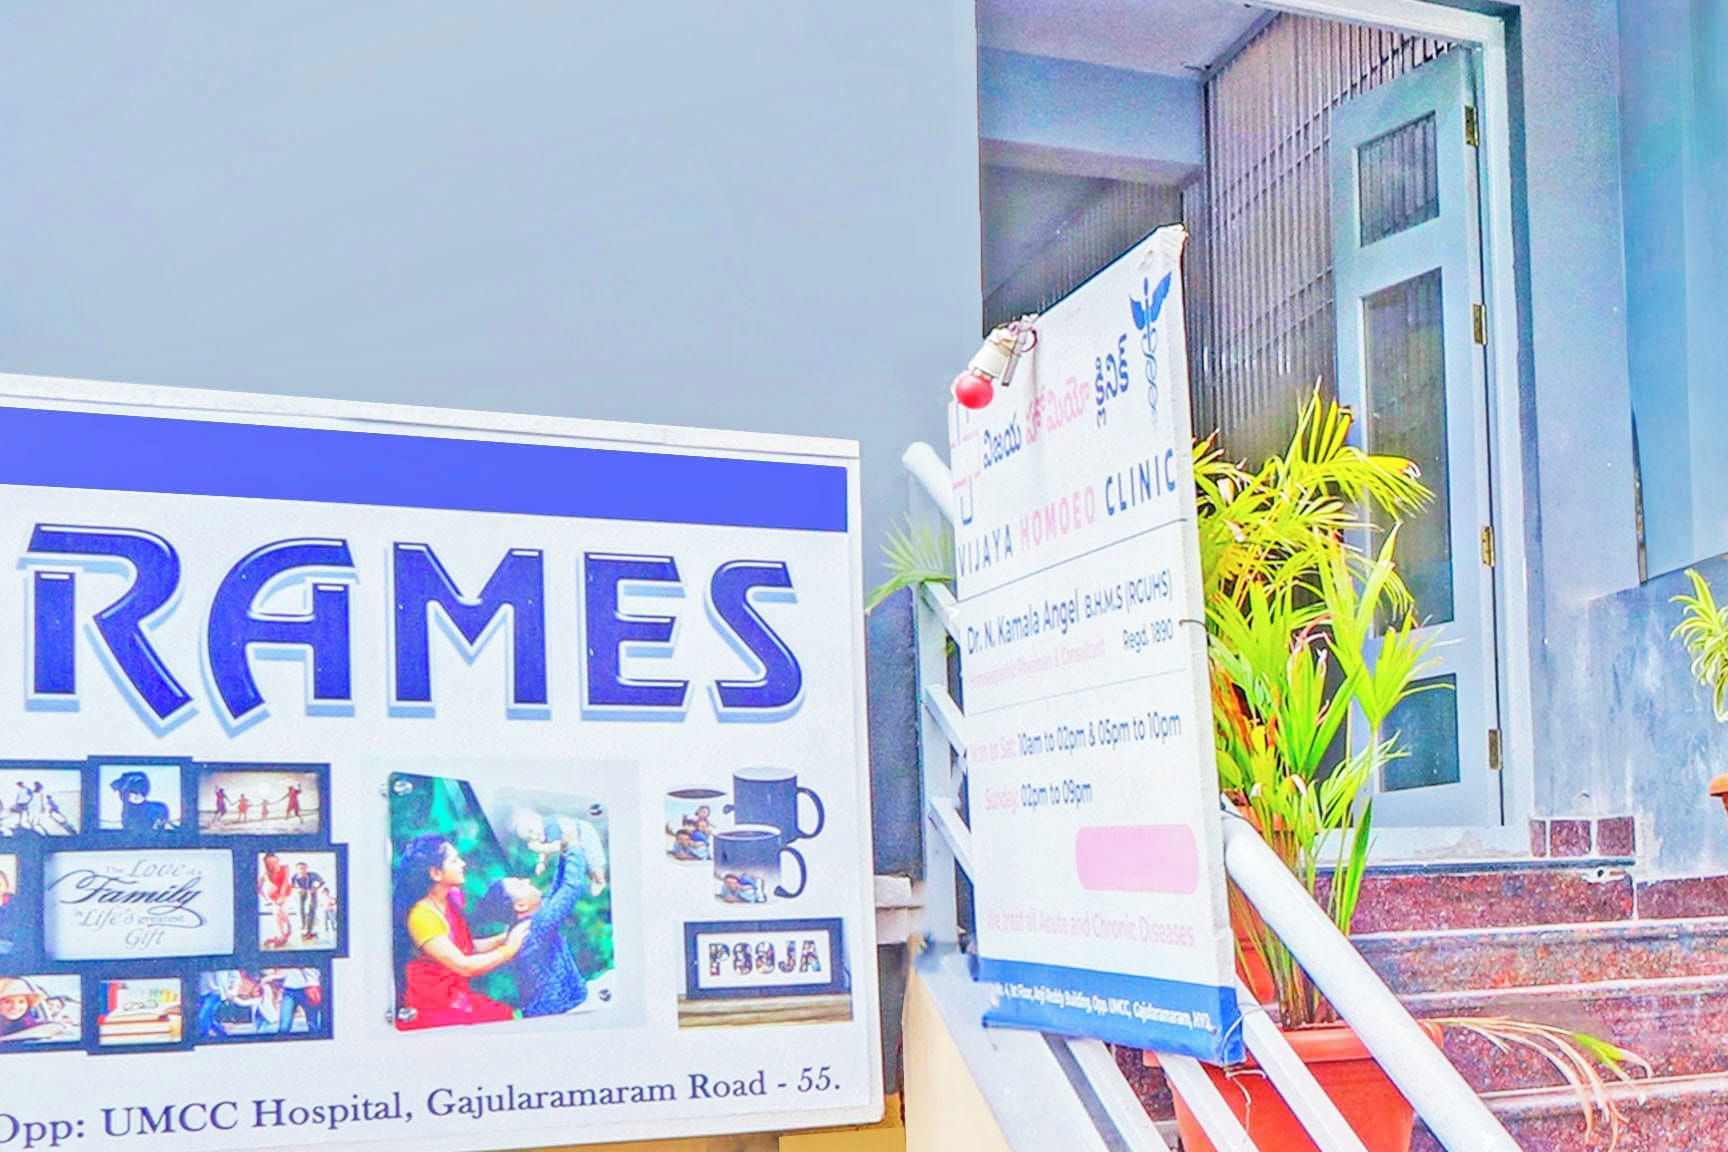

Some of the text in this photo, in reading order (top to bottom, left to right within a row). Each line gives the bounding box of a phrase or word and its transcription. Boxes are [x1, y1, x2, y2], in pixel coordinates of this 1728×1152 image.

[958, 448, 1176, 577] VIJAYA HOMOEO CLINIC
[967, 626, 983, 654] Dr.
[985, 620, 996, 648] N.
[999, 604, 1039, 643] Kamala
[1043, 588, 1080, 635] Angel
[1018, 732, 1043, 757] 10am
[1044, 731, 1055, 752] to
[1057, 726, 1086, 756] 02pm
[1088, 722, 1096, 747] &
[1132, 716, 1146, 740] to
[1147, 711, 1182, 745] 10pm
[1020, 783, 1048, 809] 02pm
[1050, 783, 1060, 804] to
[1062, 779, 1094, 809] 09pm
[48, 869, 207, 929] Family
[124, 927, 167, 951] Gift
[1092, 912, 1137, 942] Chronic
[1139, 914, 1195, 948] Diseases
[708, 940, 822, 977] POOJA
[0, 1113, 85, 1149] Opp:
[101, 1101, 238, 1137] UMCC
[252, 1092, 413, 1129] Hospital,
[427, 1078, 676, 1118] Gajularamaram
[688, 1070, 767, 1099] Road
[797, 1066, 841, 1092] 55.
